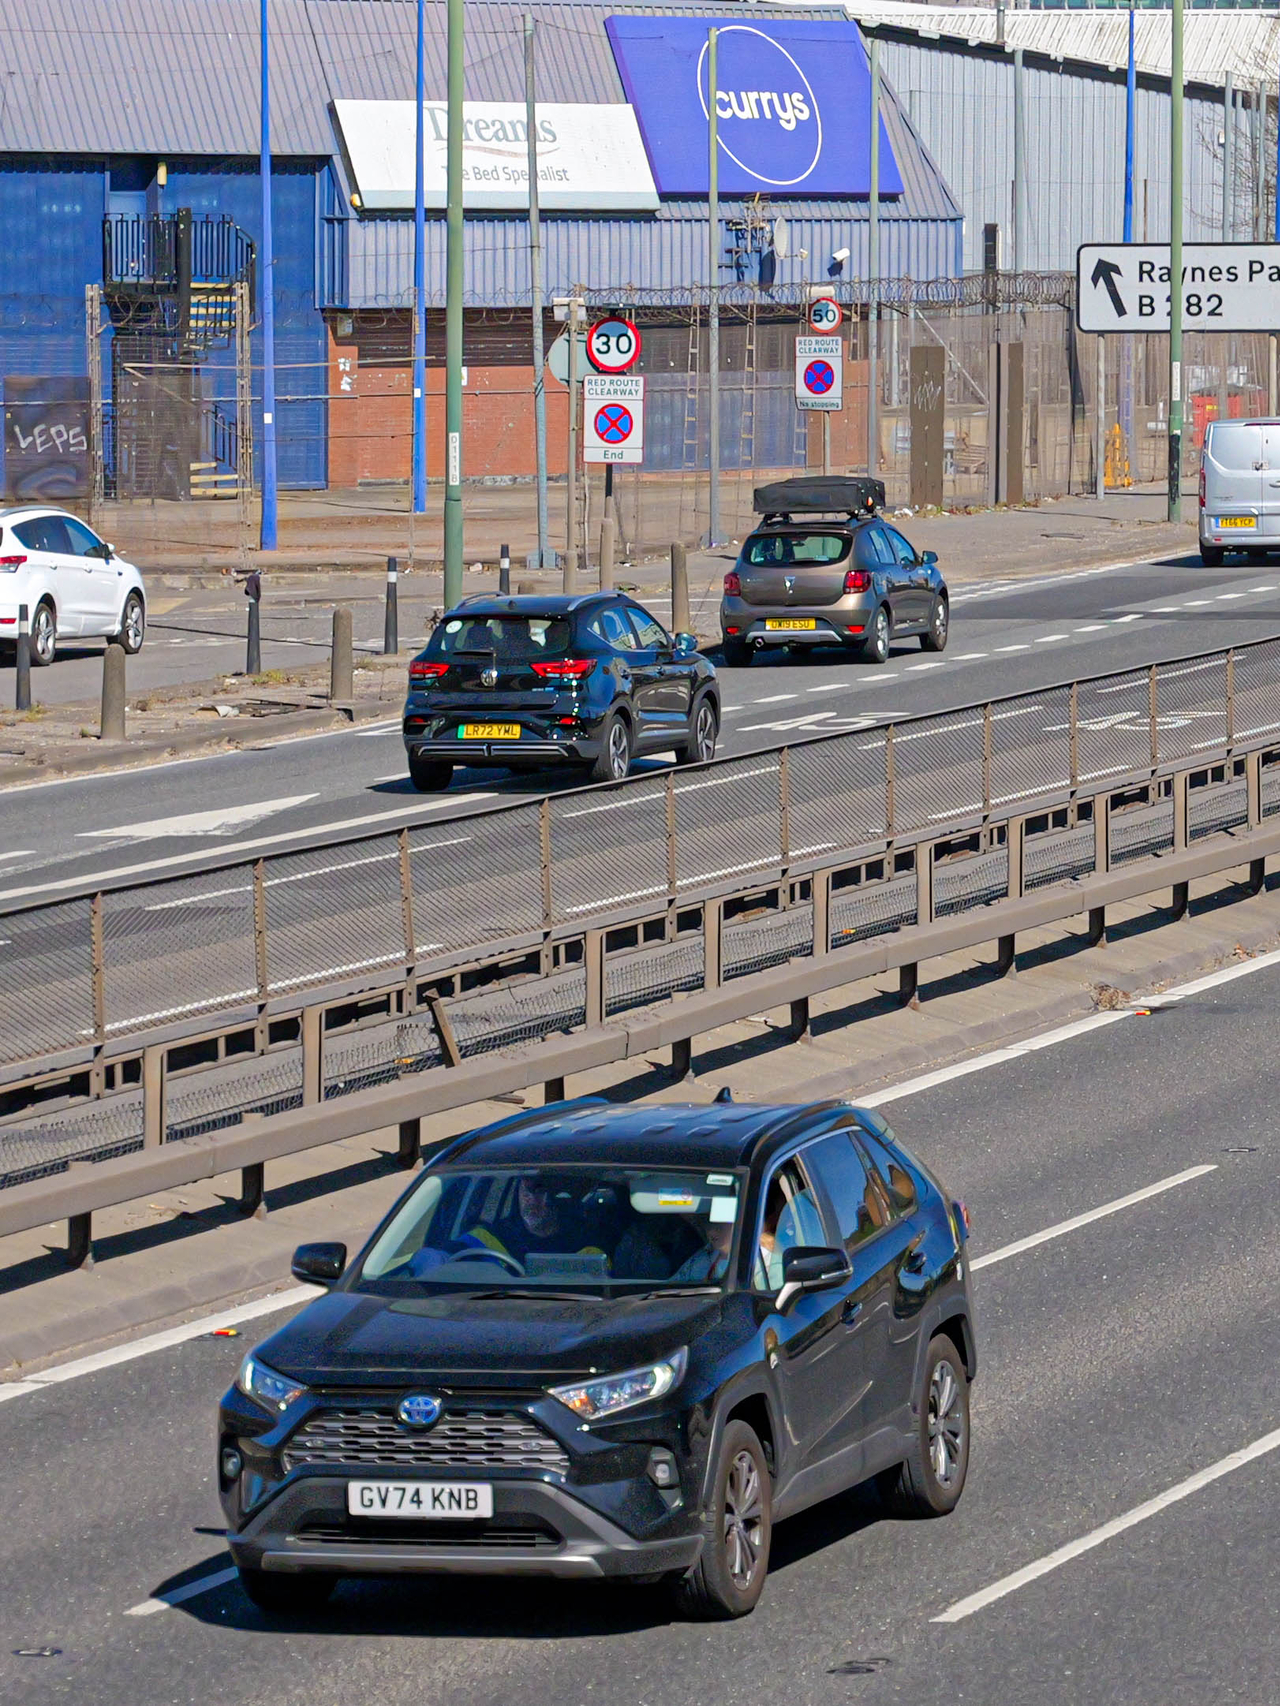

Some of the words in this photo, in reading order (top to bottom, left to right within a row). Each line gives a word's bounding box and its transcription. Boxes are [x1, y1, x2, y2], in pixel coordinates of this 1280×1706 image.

[715, 90, 810, 131] currys
[472, 166, 499, 181] Bed
[1138, 295, 1156, 317] B
[812, 309, 836, 323] 50
[595, 333, 632, 354] 30
[587, 379, 606, 387] RED
[609, 379, 640, 387] ROUTE
[588, 388, 640, 396] CLEARWAY
[14, 424, 87, 453] LEPS
[603, 450, 624, 460] End
[465, 725, 494, 736] LR72
[360, 1486, 423, 1510] GV74
[431, 1487, 479, 1511] KNB
